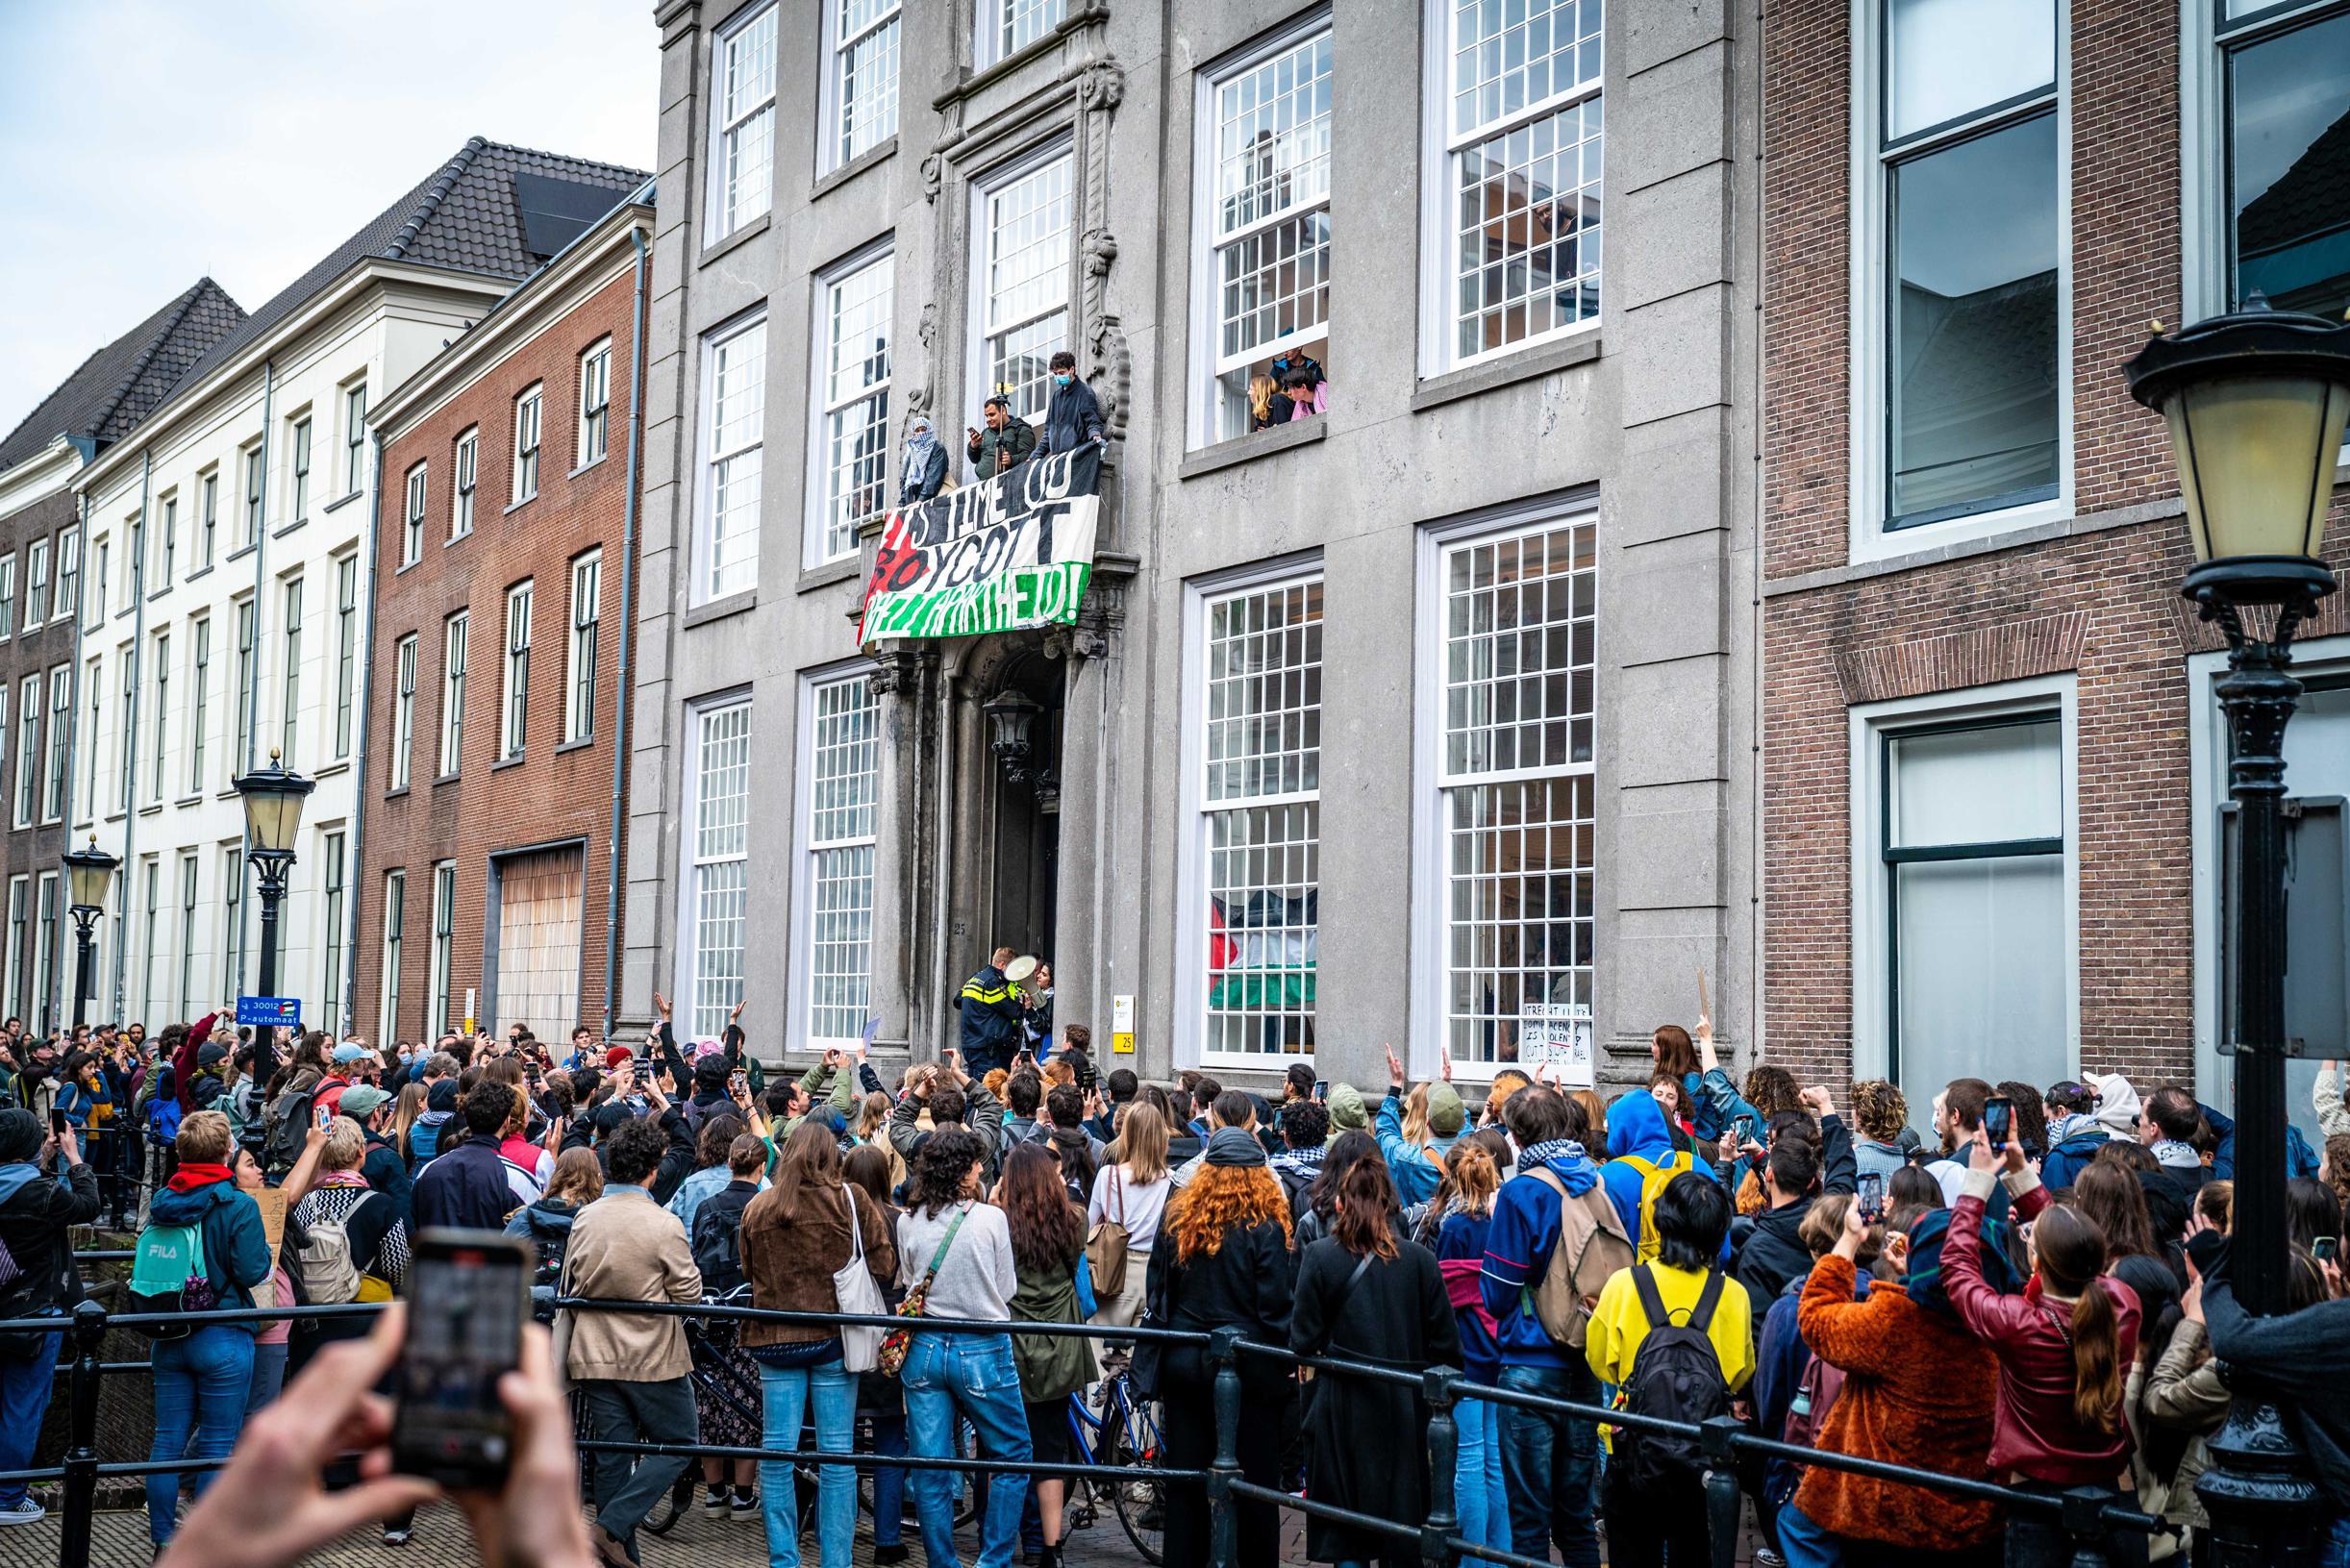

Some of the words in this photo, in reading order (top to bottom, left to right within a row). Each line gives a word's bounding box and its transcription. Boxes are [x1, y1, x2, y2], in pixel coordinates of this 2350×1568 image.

[946, 474, 1007, 542] TIME
[869, 502, 1071, 593] BOYCOTT
[954, 923, 965, 935] 25
[253, 1002, 279, 1010] 30012
[240, 1014, 297, 1024] P-automaat
[1123, 1037, 1131, 1048] 25
[270, 1194, 283, 1231] FROM
[148, 1244, 177, 1259] FILA
